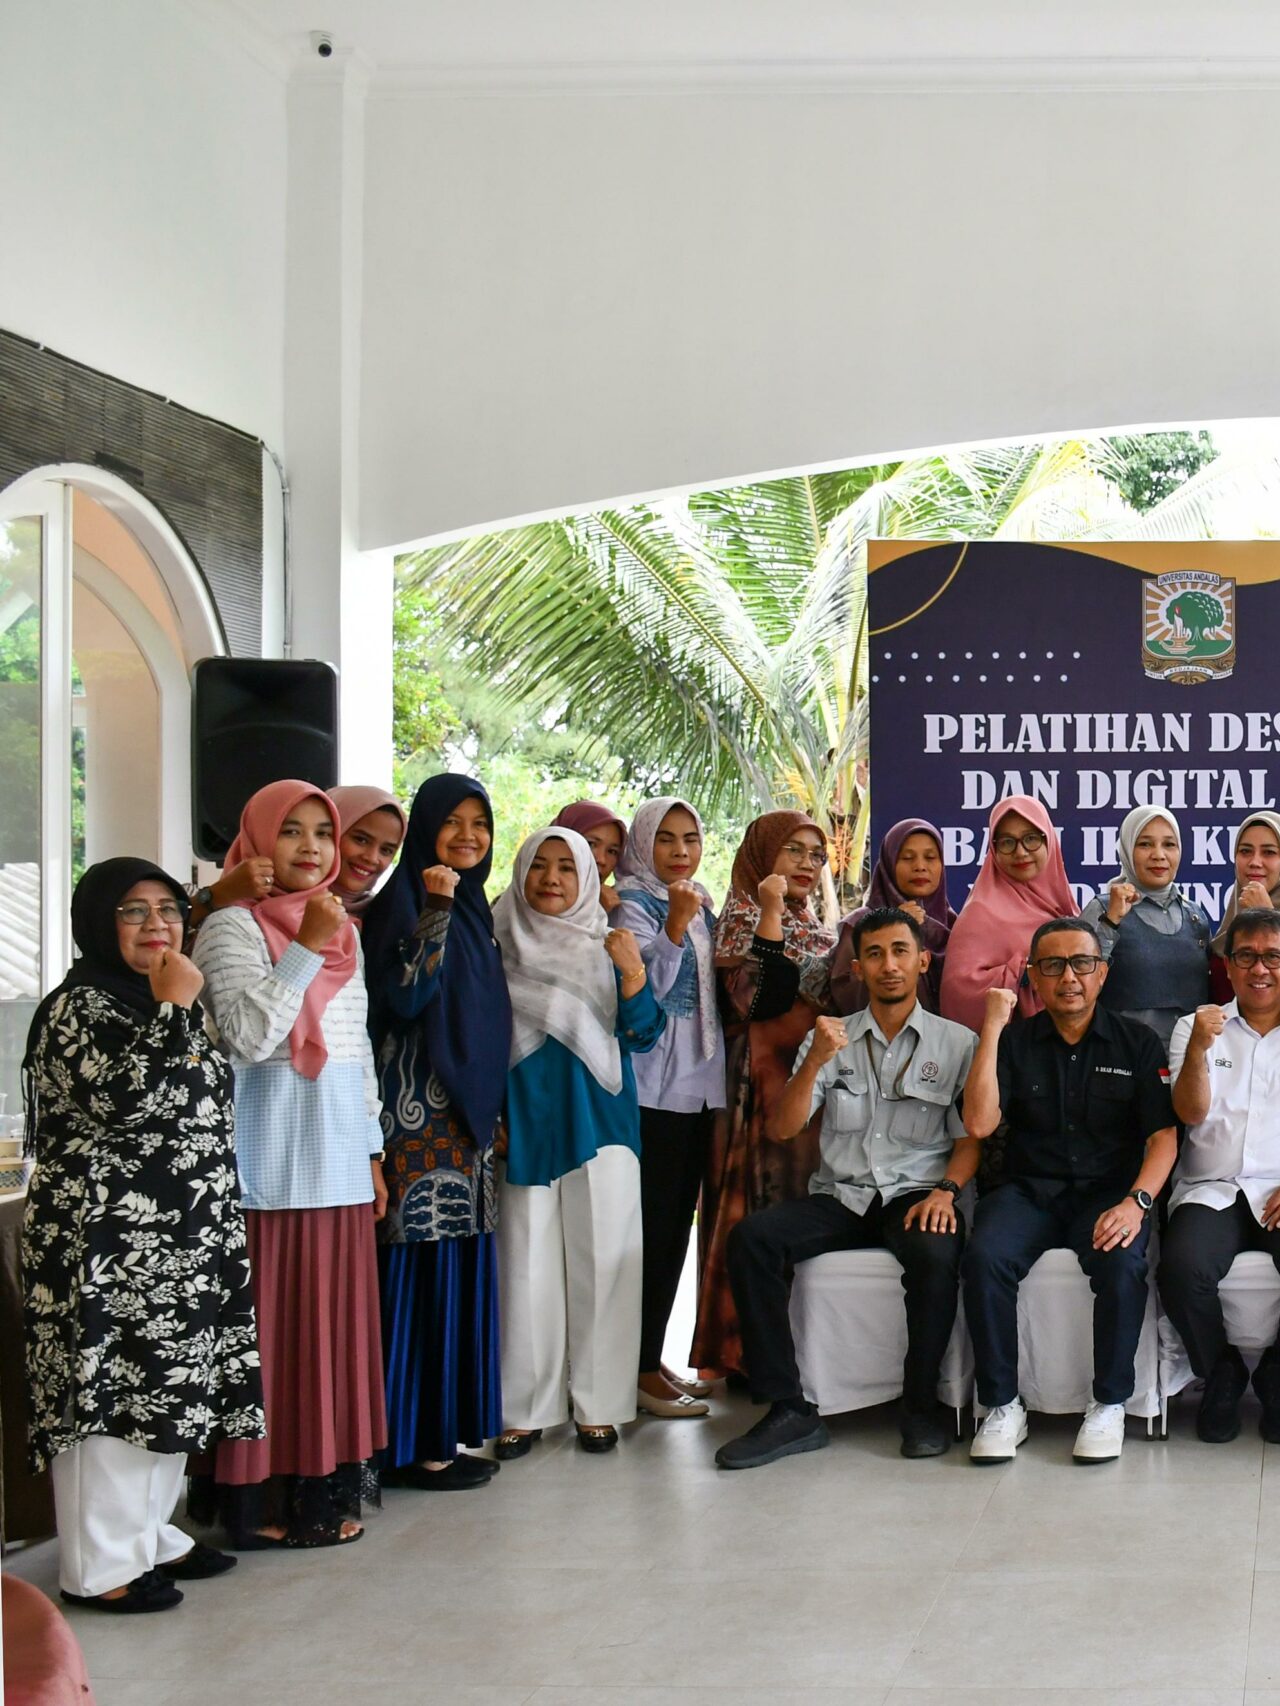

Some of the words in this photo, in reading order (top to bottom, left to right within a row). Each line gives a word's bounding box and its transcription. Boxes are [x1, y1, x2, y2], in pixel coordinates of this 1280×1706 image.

[1158, 572, 1193, 584] UNIVERSITAS
[1193, 573, 1219, 584] ANDALAS
[923, 712, 1192, 754] PELATIHAN
[960, 769, 1061, 810] DAN
[1076, 768, 1276, 810] DIGITAL
